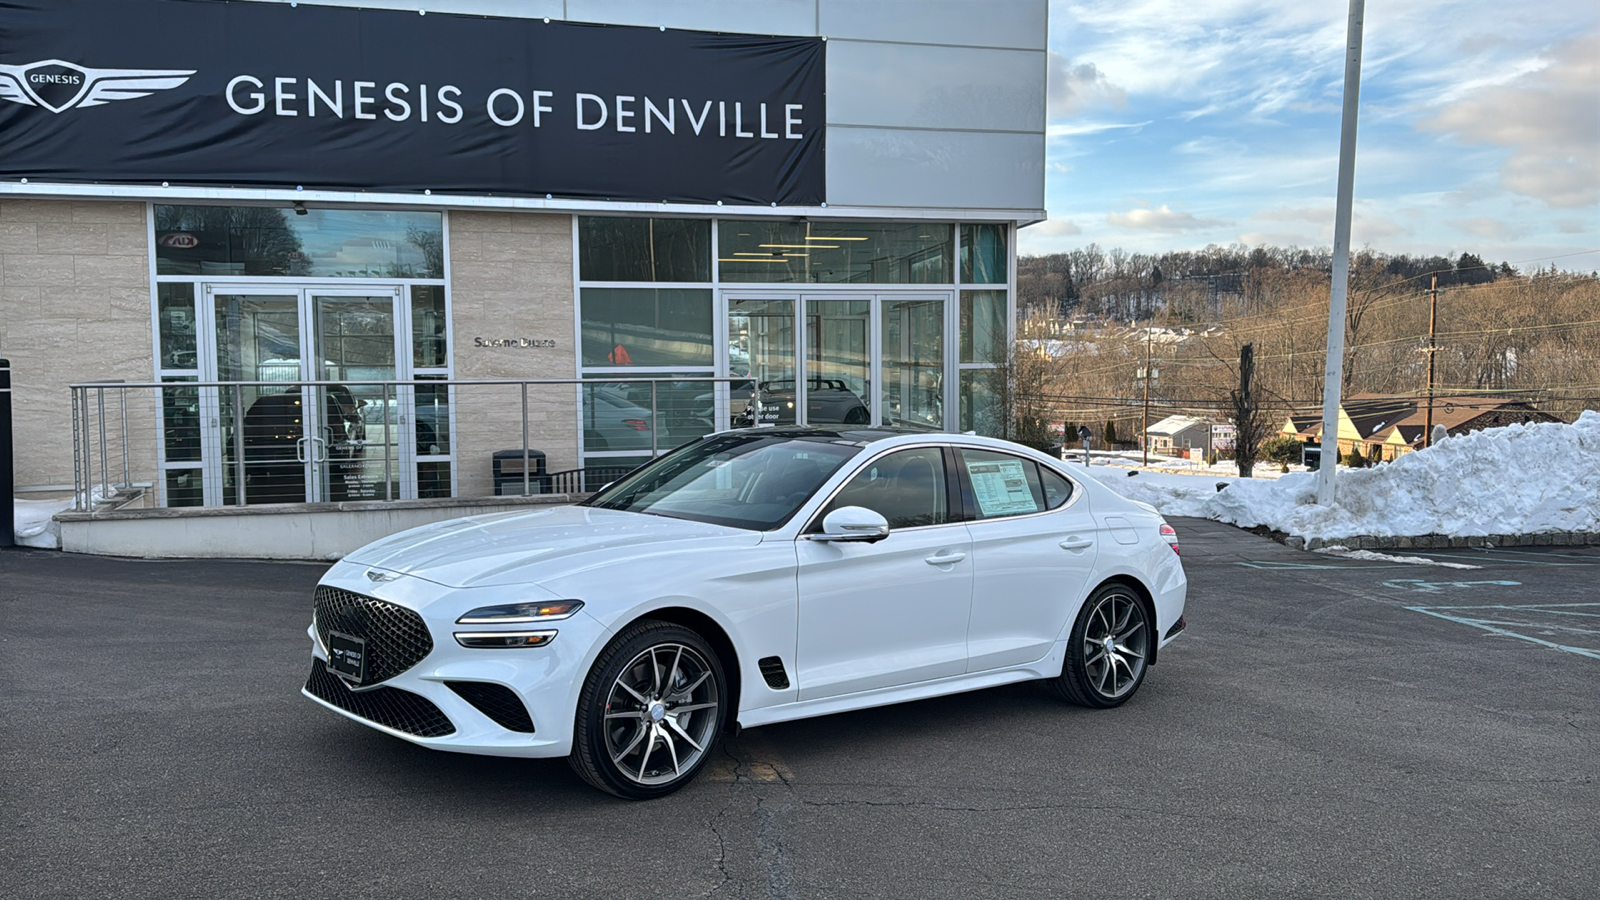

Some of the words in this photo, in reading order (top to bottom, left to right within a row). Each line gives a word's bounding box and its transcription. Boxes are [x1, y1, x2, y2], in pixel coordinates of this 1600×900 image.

[30, 73, 80, 85] GENESIS
[225, 75, 464, 124] GENESIS
[486, 87, 554, 128] OF
[576, 92, 803, 140] DENVILLE
